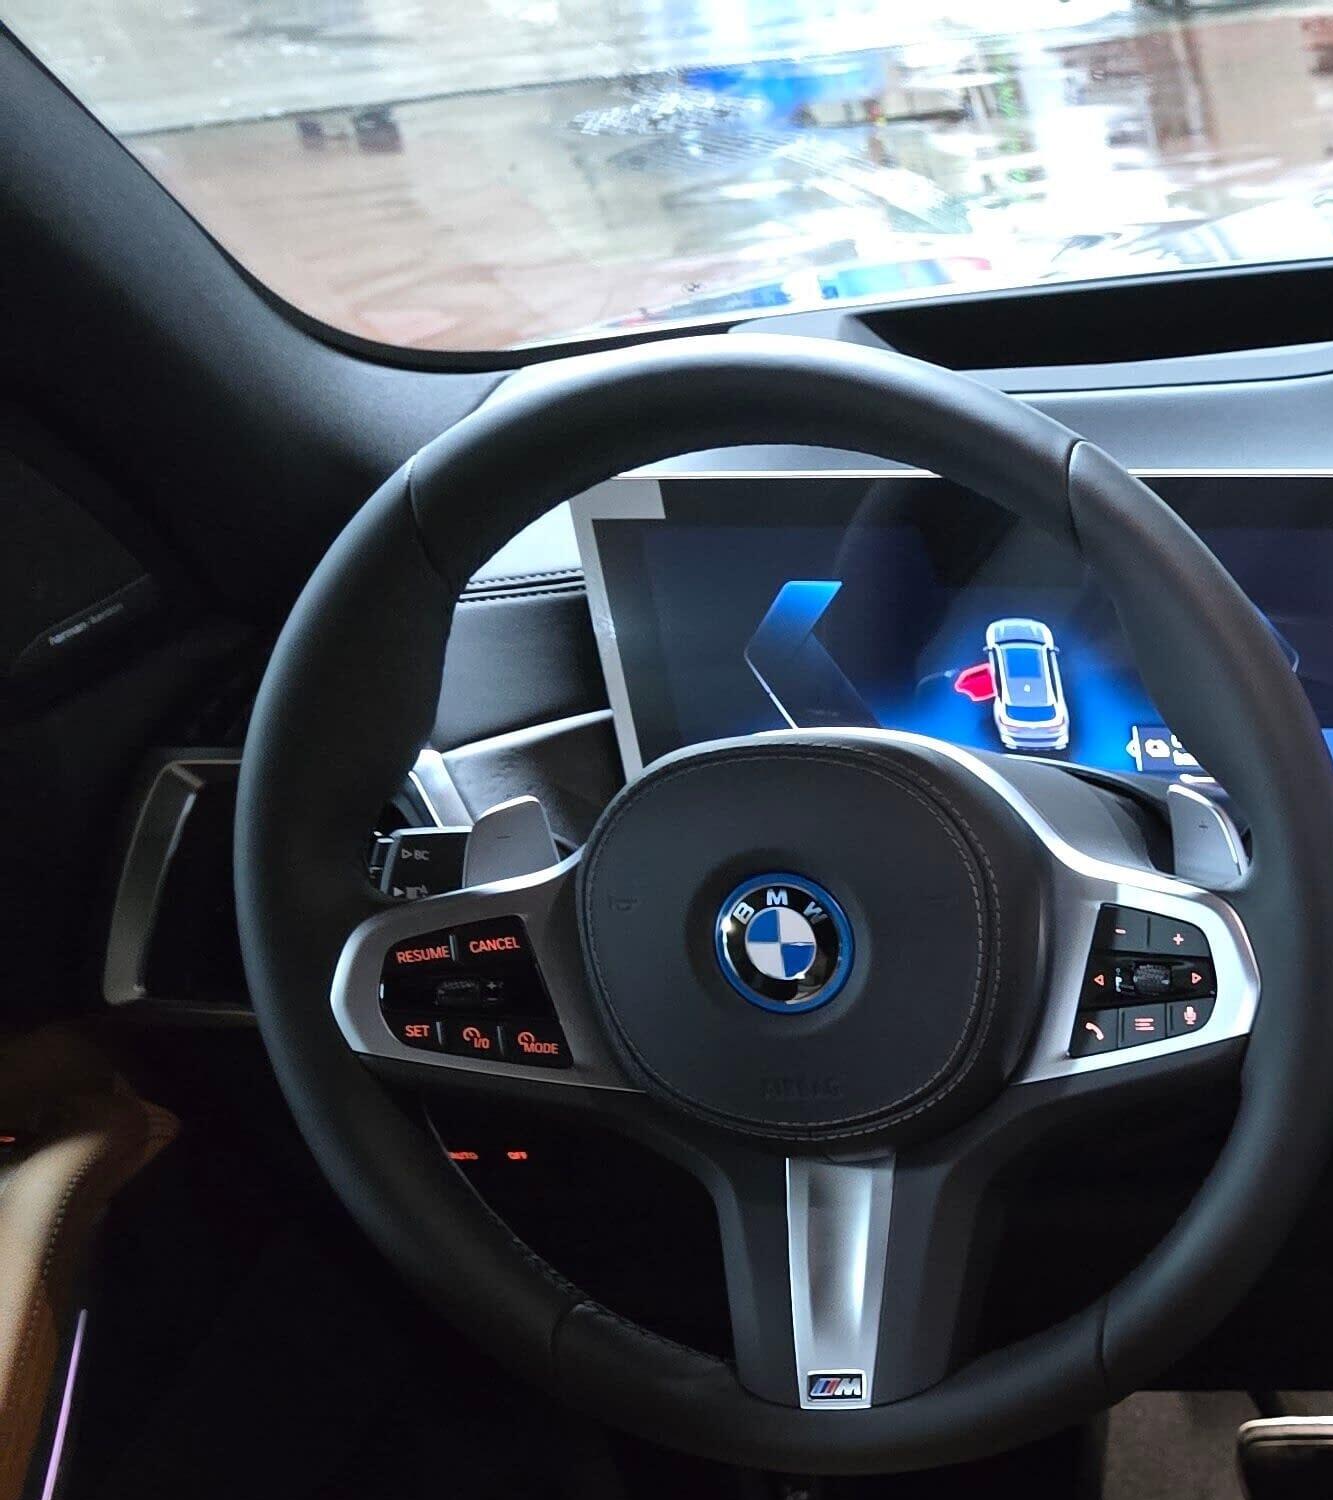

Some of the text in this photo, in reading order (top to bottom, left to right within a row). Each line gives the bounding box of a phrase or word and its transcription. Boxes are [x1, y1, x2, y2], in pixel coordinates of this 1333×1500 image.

[733, 888, 828, 925] BMW
[469, 936, 521, 954] CANCEL
[396, 946, 451, 964] RESUME
[405, 1024, 430, 1038] SET
[523, 1042, 559, 1055] MODE
